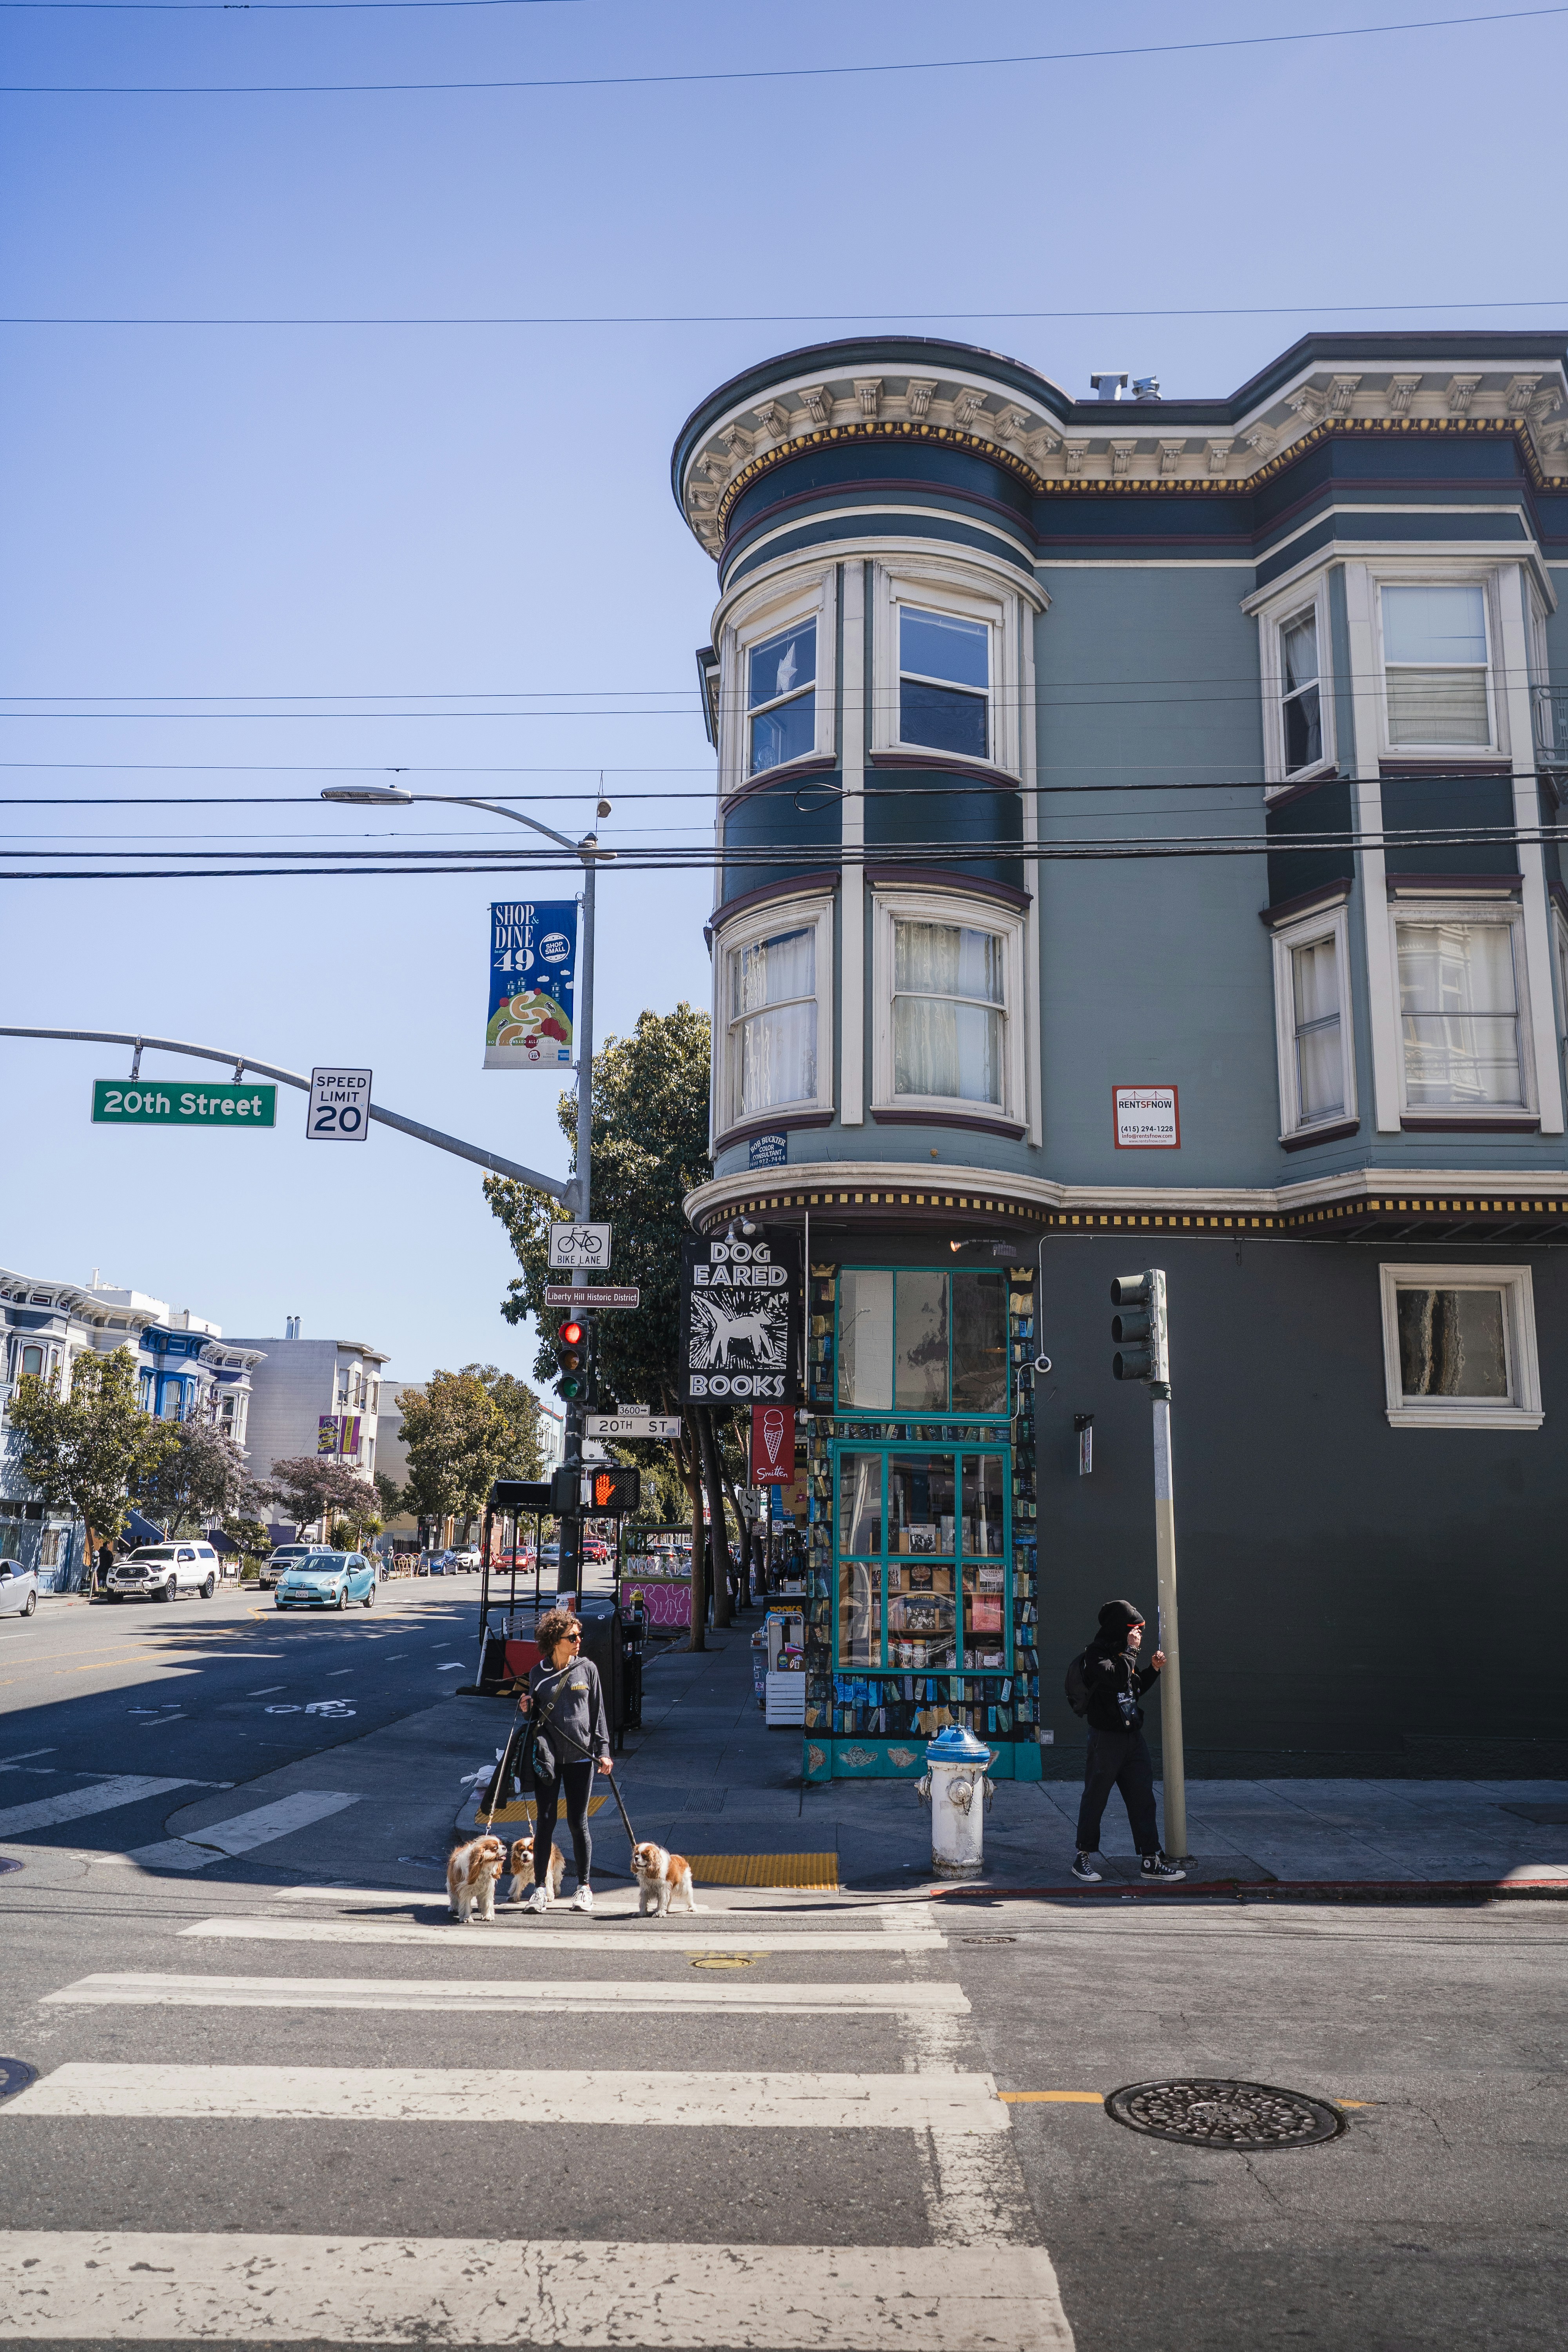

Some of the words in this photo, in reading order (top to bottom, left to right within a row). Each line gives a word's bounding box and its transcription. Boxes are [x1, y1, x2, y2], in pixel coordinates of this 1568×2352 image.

[495, 905, 534, 926] SHOP
[495, 926, 534, 948] DINE
[545, 946, 565, 955] SMALL
[494, 949, 534, 971] 49
[317, 1076, 367, 1088] SPEED
[104, 1091, 171, 1114] 20th
[179, 1093, 262, 1116] Street
[320, 1091, 359, 1103] LIMIT
[314, 1105, 361, 1132] 20
[750, 1140, 761, 1154] BOB
[761, 1136, 786, 1147] BUCKTER
[759, 1144, 774, 1152] COLOR
[753, 1149, 782, 1160] CONSULTANT
[557, 1255, 575, 1264] BIKE
[579, 1256, 601, 1264] LANE
[710, 1242, 771, 1263] DOG
[693, 1265, 788, 1286] EARED
[548, 1292, 572, 1302] Liberty
[690, 1375, 786, 1397] BOOKS
[599, 1420, 632, 1432] 20TH
[648, 1421, 668, 1432] ST
[757, 1465, 788, 1480] Smitten
